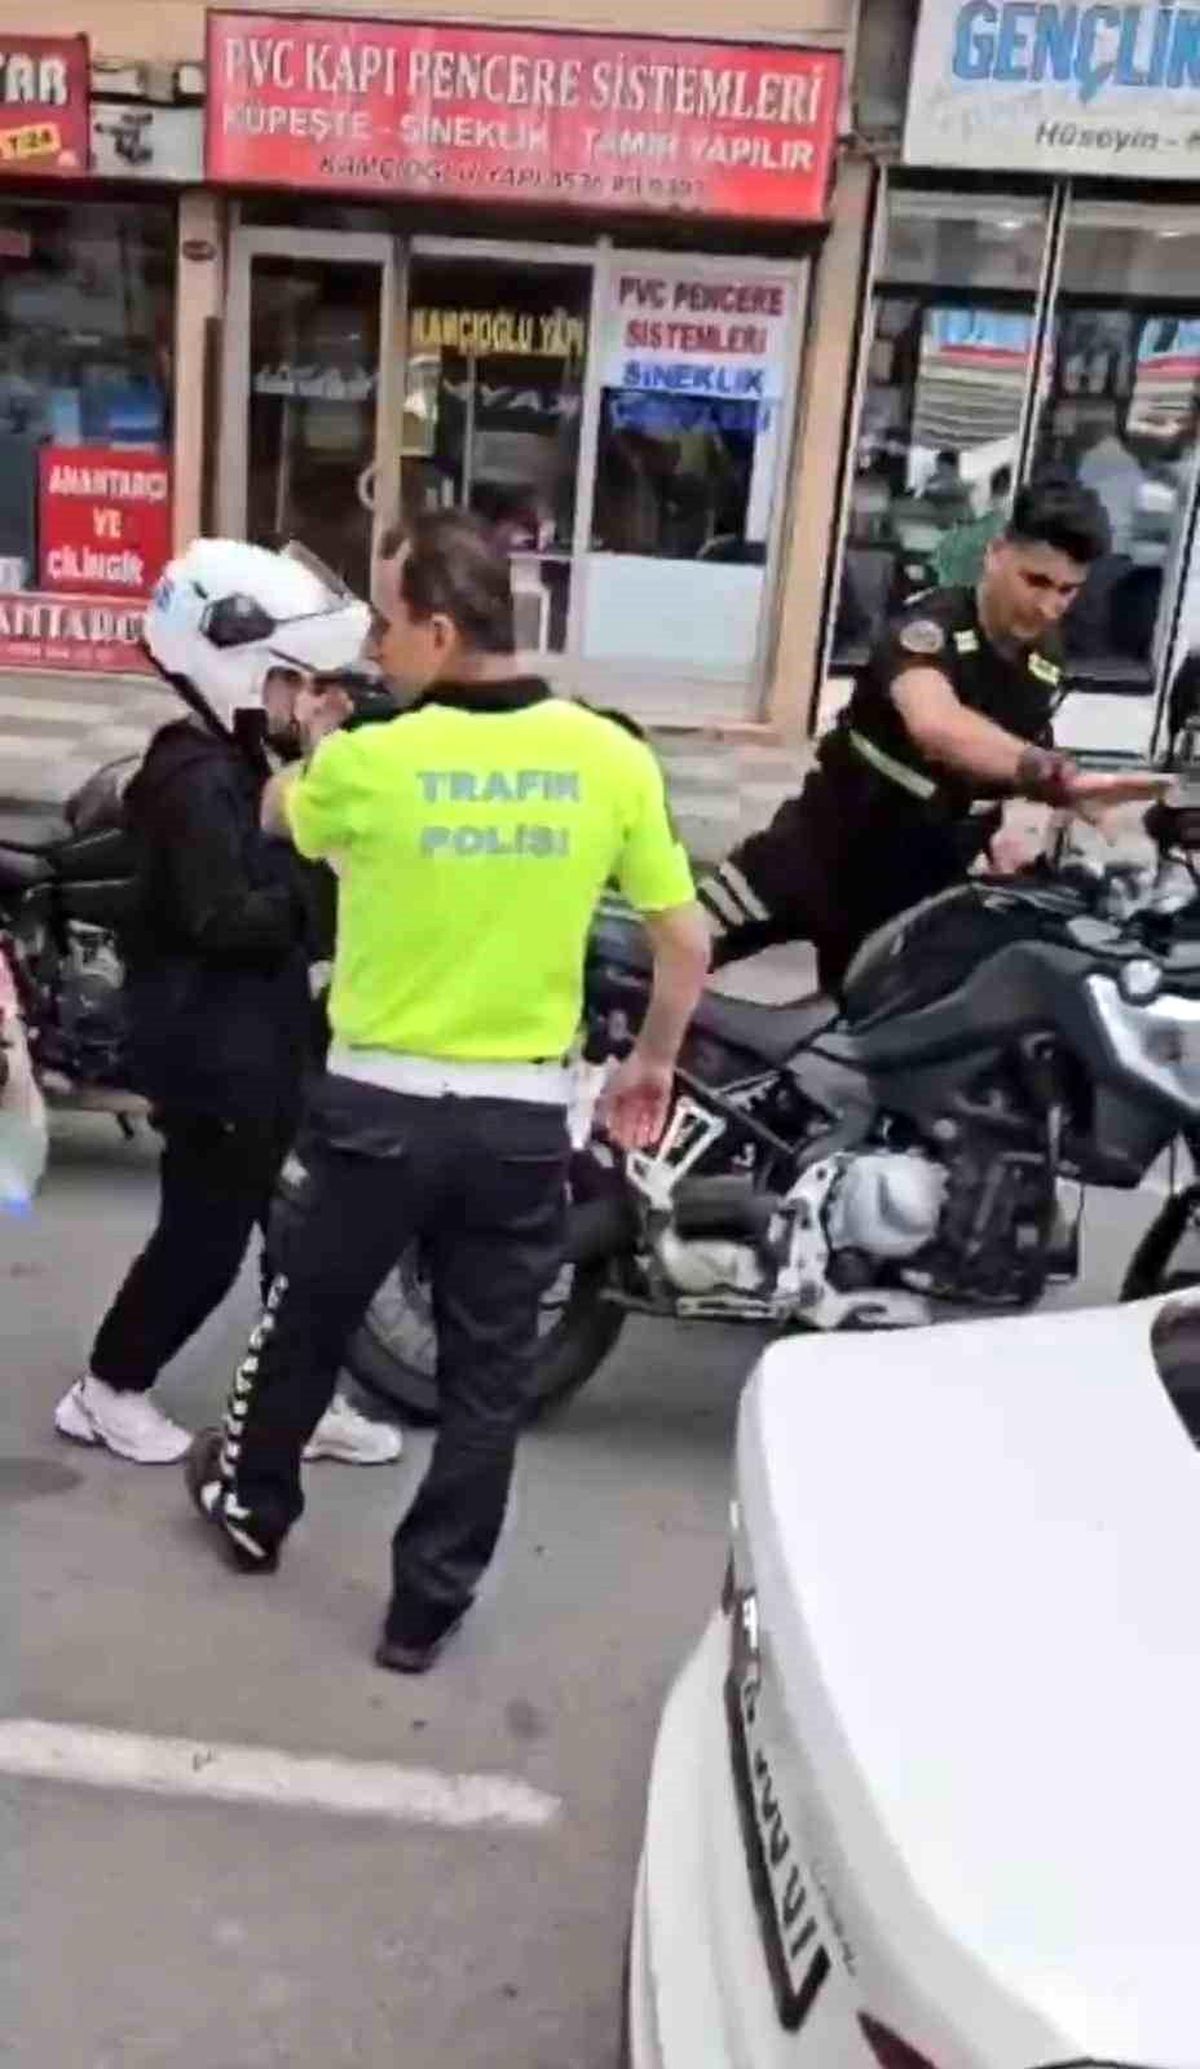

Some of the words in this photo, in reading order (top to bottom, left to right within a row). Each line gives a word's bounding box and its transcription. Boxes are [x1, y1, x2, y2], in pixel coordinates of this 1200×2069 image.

[0, 52, 68, 105] AR
[225, 37, 297, 90] PVC
[305, 42, 398, 96] KAPI
[408, 49, 582, 107] PENCERE
[591, 53, 826, 125] SİSTEMLERİ
[620, 275, 666, 309] PVC
[674, 279, 784, 317] PENCERE
[93, 505, 122, 539] VE
